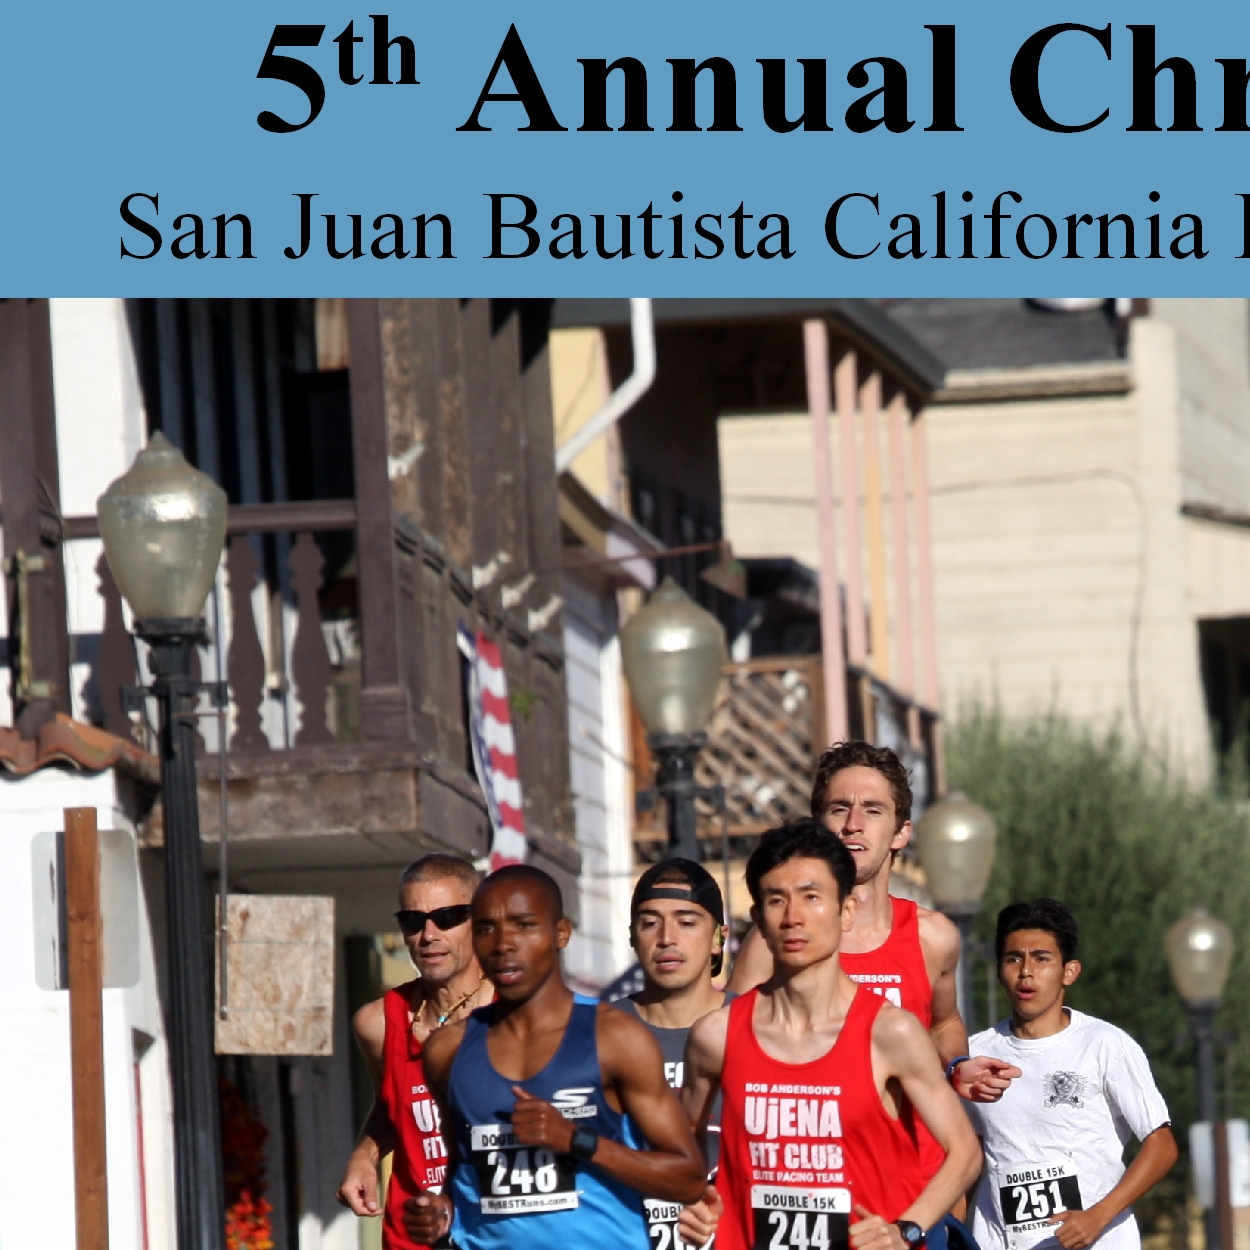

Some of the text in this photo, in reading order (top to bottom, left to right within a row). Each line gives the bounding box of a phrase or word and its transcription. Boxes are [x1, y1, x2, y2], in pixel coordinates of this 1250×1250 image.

[846, 974, 902, 984] DERSON'S
[411, 1085, 428, 1094] BO
[745, 1083, 842, 1096] BOB ANDERSON'S
[481, 1133, 518, 1147] DOUB
[749, 1142, 844, 1170] FIT CLUB
[487, 1147, 557, 1195] 248
[753, 1170, 844, 1183] ELITE RACING TEAM
[1006, 1165, 1066, 1184] DOUBLE 15K
[487, 1198, 568, 1211] MyBESTRuns.com
[763, 1193, 836, 1209] DOUBLE 15K
[1012, 1181, 1067, 1221] 251
[646, 1205, 682, 1220] OUB
[1012, 1220, 1062, 1234] MyBESTR
